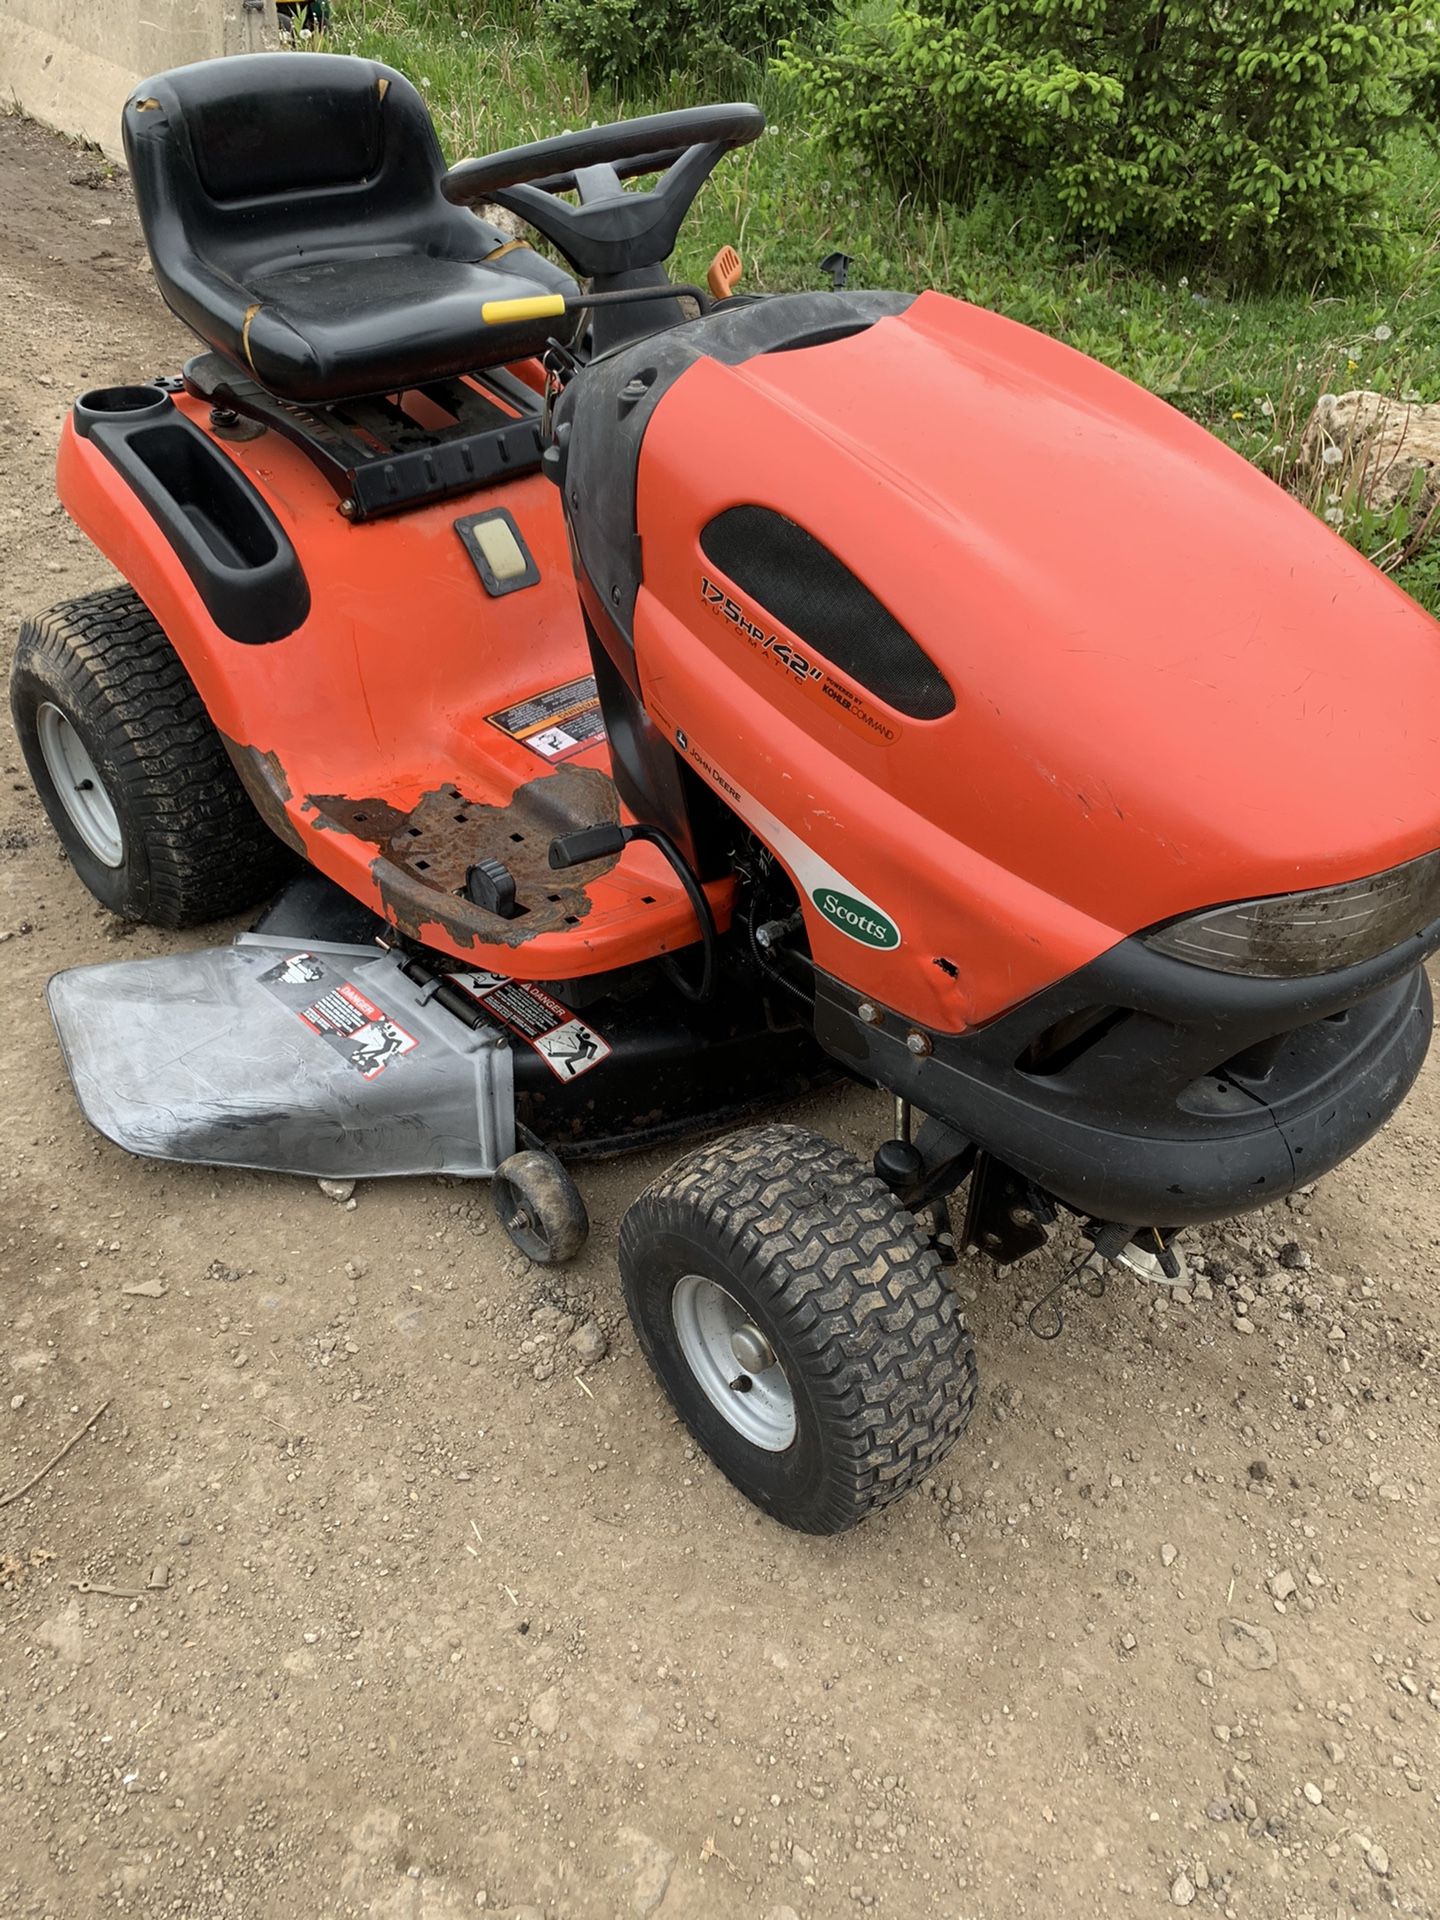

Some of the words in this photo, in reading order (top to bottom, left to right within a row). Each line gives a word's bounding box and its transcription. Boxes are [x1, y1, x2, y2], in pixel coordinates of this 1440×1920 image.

[700, 598, 804, 686] AUTOMATIC
[822, 684, 852, 712] KOHLER
[851, 705, 894, 740] COMMAND
[826, 676, 854, 700] POWERED
[853, 696, 863, 706] BY
[689, 748, 712, 774] JOHN
[712, 769, 742, 803] DEERE
[823, 894, 887, 941] Scotts
[341, 986, 375, 1014] DANGER
[529, 988, 566, 1017] DANGER
